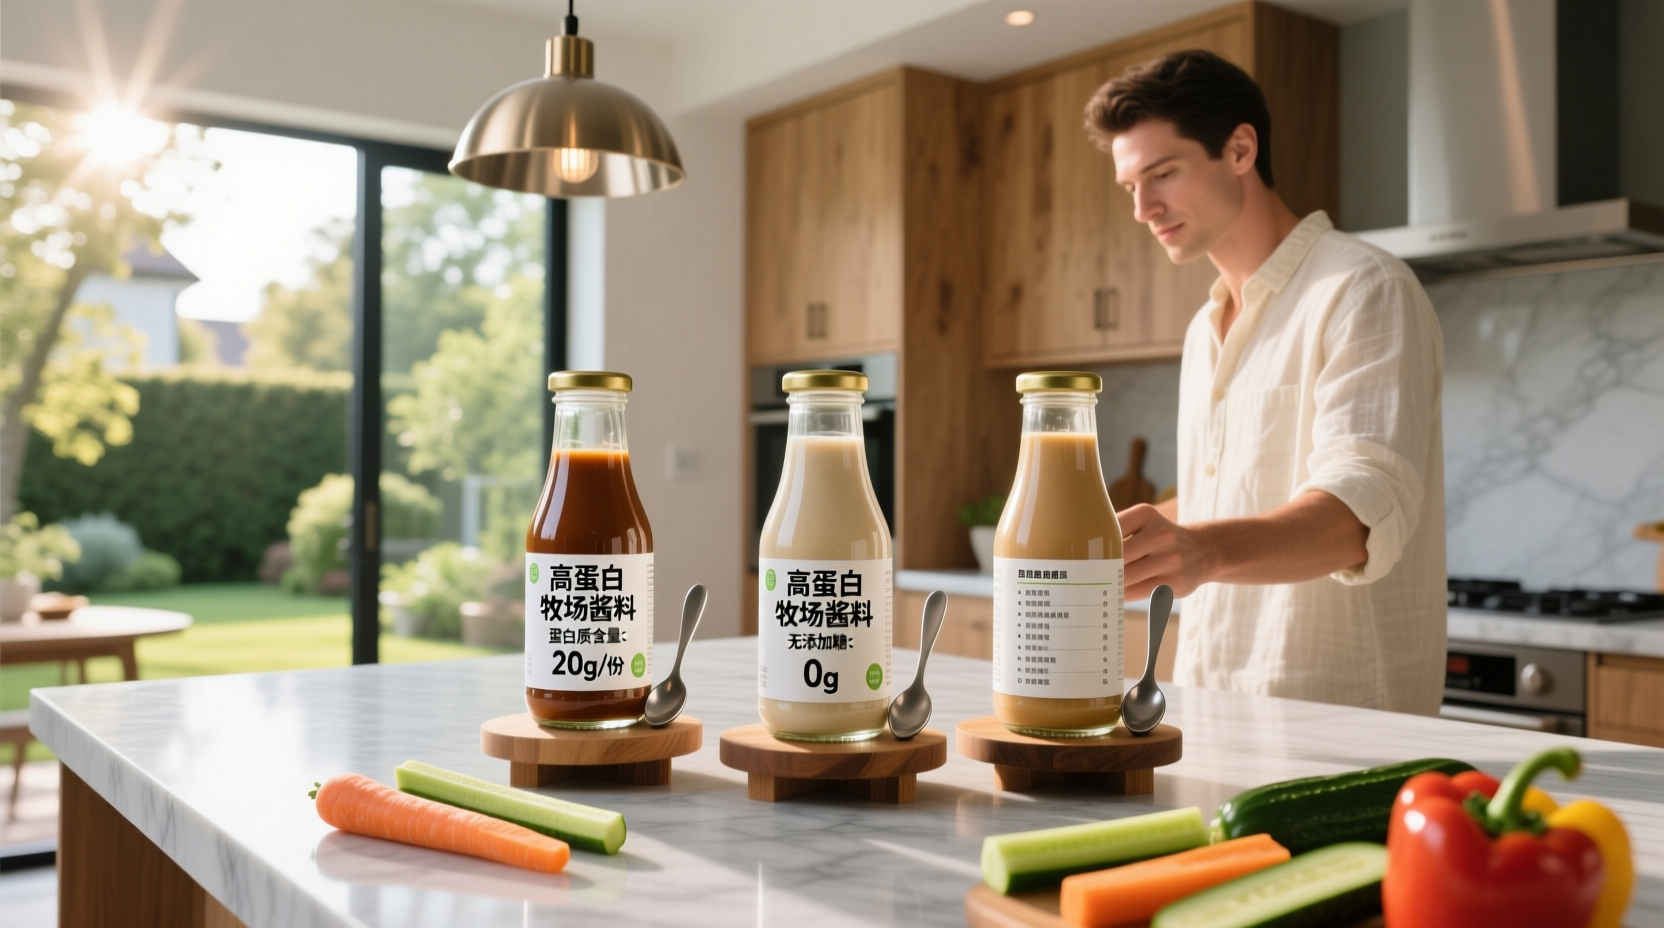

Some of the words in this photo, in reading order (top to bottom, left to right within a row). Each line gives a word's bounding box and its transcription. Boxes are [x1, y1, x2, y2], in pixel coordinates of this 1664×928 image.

[550, 564, 623, 592] 高蛋白
[787, 569, 862, 597] 高蛋白
[540, 594, 636, 622] 牧场酱料
[775, 600, 873, 628] 牧场酱料
[551, 650, 624, 681] 20g/份
[803, 658, 839, 694] 0g
